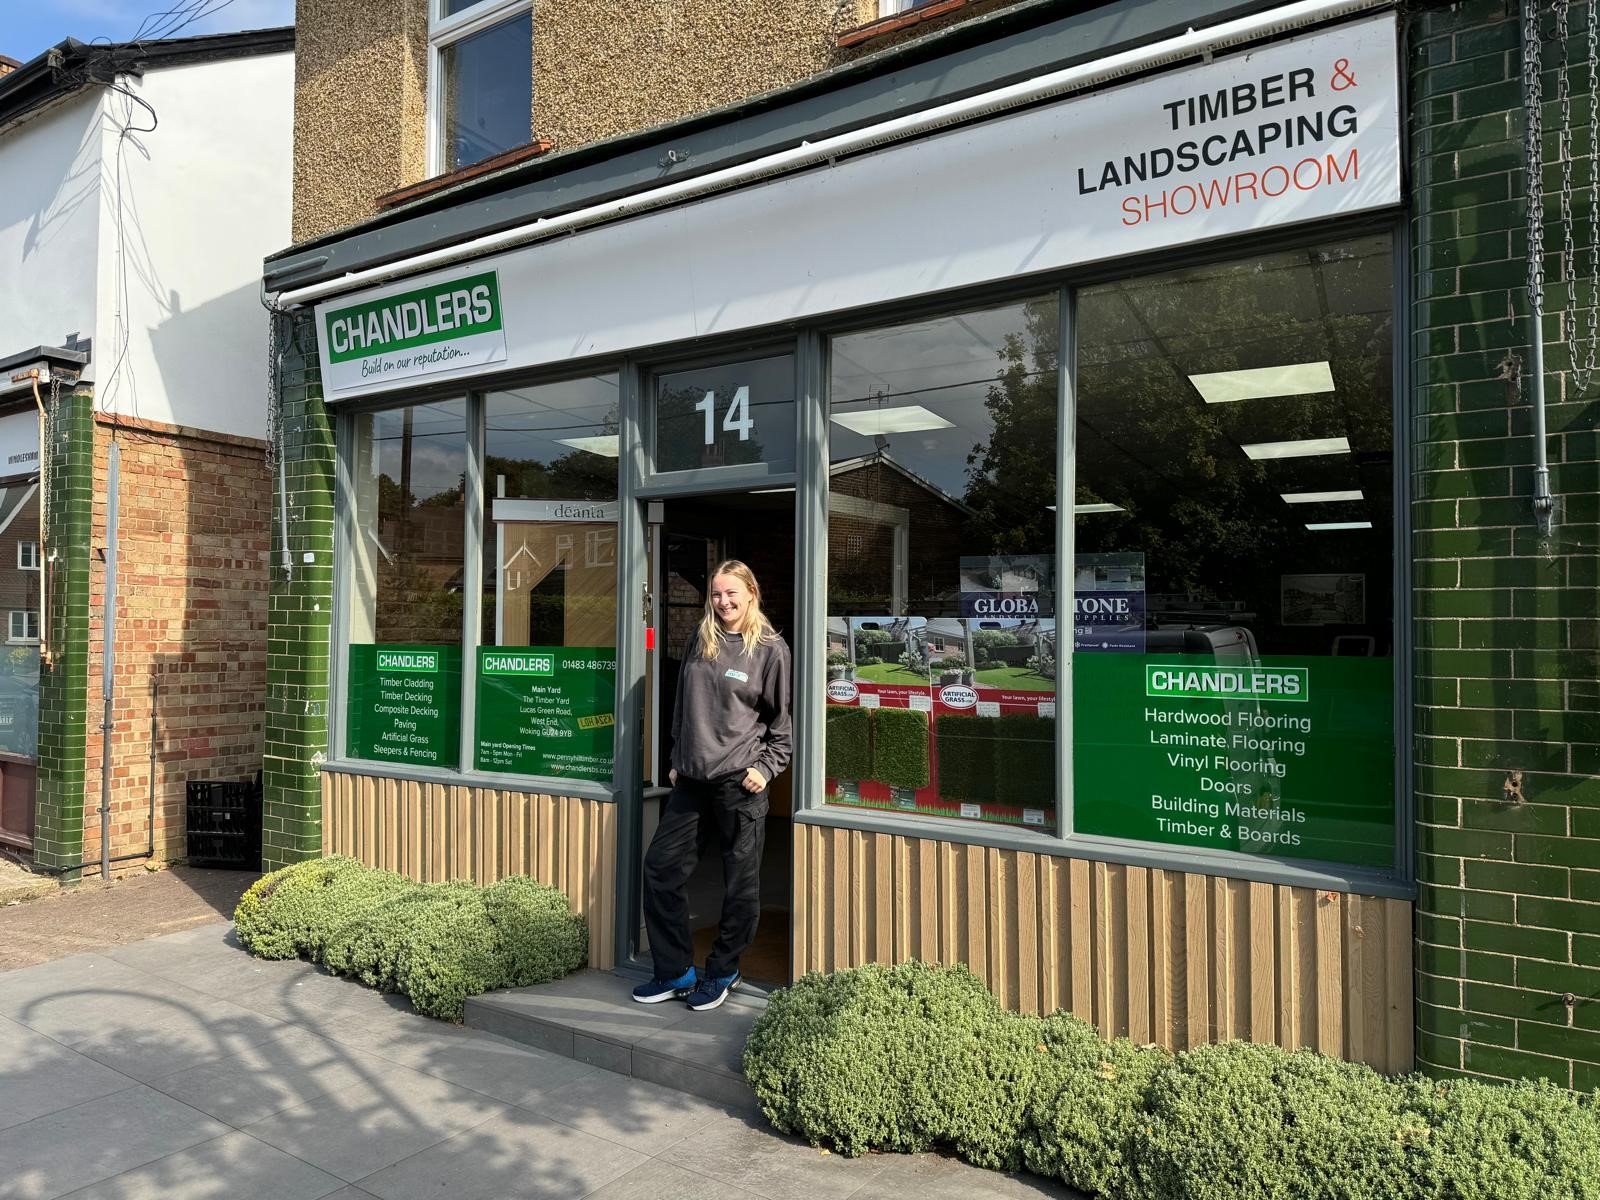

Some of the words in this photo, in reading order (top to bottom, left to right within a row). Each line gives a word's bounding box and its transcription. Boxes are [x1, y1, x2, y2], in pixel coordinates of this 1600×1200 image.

[1163, 67, 1315, 130] TIMBER
[1330, 58, 1358, 91] &
[1078, 104, 1358, 195] LANDSCAPING
[1121, 148, 1359, 226] SHOWROOM
[331, 284, 492, 353] CHANDLERS
[361, 357, 382, 378] Build
[384, 361, 395, 372] on
[397, 358, 411, 368] our
[414, 346, 470, 370] reputation...
[695, 386, 754, 445] 14
[974, 598, 1039, 613] GLOBA
[1073, 598, 1130, 613] TONE
[379, 655, 435, 668] CHANDLERS
[485, 657, 550, 671] CHANDLERS
[562, 660, 585, 669] 01483
[586, 660, 616, 670] 486739
[380, 677, 402, 687] Timber
[404, 678, 434, 690] Cladding
[547, 686, 561, 694] Yard
[1151, 671, 1301, 695] CHANDLERS
[381, 690, 403, 700] Timber
[405, 692, 433, 704] Decking
[535, 696, 555, 704] Timber
[556, 697, 570, 705] Yard
[374, 703, 409, 715] Composite
[410, 705, 439, 718] Decking
[556, 707, 573, 717] Road,
[394, 718, 417, 731] Paving
[531, 717, 545, 725] West
[546, 717, 559, 727] End,
[1145, 707, 1232, 726] Hardwood
[1238, 712, 1311, 733] Flooring
[382, 731, 408, 742] Artificial
[409, 733, 429, 744] Grass
[520, 727, 541, 736] Woking
[541, 728, 559, 736] GU24
[560, 729, 572, 738] 9YB
[502, 742, 521, 750] Opening
[522, 743, 536, 751] Times
[1150, 730, 1226, 748] Laminate
[1232, 735, 1305, 756] Flooring
[373, 744, 402, 756] Sleepers
[403, 746, 409, 756] &
[410, 747, 437, 760] Fencing
[492, 757, 504, 765] 12pm
[1167, 753, 1208, 771] Vinyl
[1214, 756, 1286, 777] Flooring
[1201, 777, 1252, 794] Doors
[1151, 795, 1219, 818] Building
[1225, 802, 1306, 823] Materials
[1156, 817, 1215, 837] Timber
[1220, 824, 1232, 839] &
[1238, 826, 1301, 846] Boards
